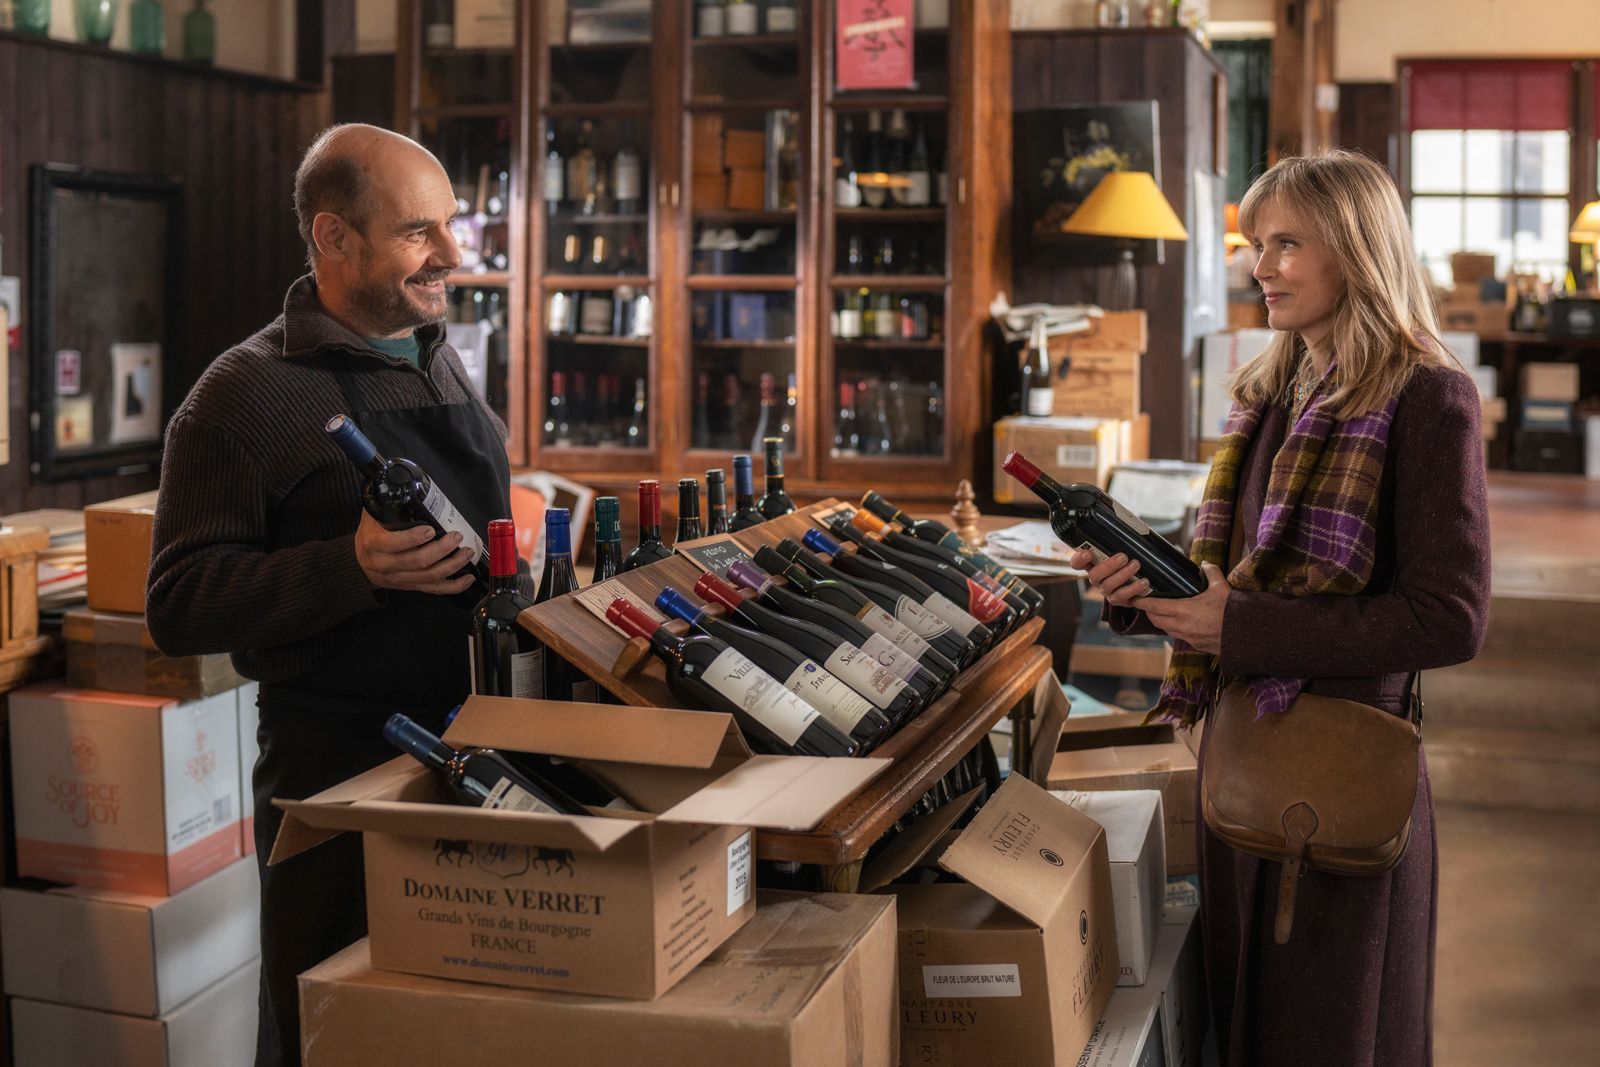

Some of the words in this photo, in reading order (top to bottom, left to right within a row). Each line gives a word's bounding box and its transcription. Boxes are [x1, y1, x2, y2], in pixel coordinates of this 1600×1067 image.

[45, 774, 121, 802] SOURCE
[73, 801, 121, 828] JOY
[992, 812, 1031, 856] FLEURY
[403, 878, 498, 906] DOMAINE
[504, 888, 606, 915] VERRET
[418, 907, 463, 925] Grands
[467, 911, 496, 928] Vins
[500, 916, 514, 930] de
[518, 918, 591, 940] Bourgogne
[471, 933, 537, 954] FRANCE
[442, 955, 569, 977] www.domaineverret.com
[933, 976, 949, 984] FLEUR
[949, 976, 957, 984] DE
[957, 975, 980, 984] L'EUROPE
[981, 975, 994, 984] BRUT
[994, 975, 1015, 983] NATURE
